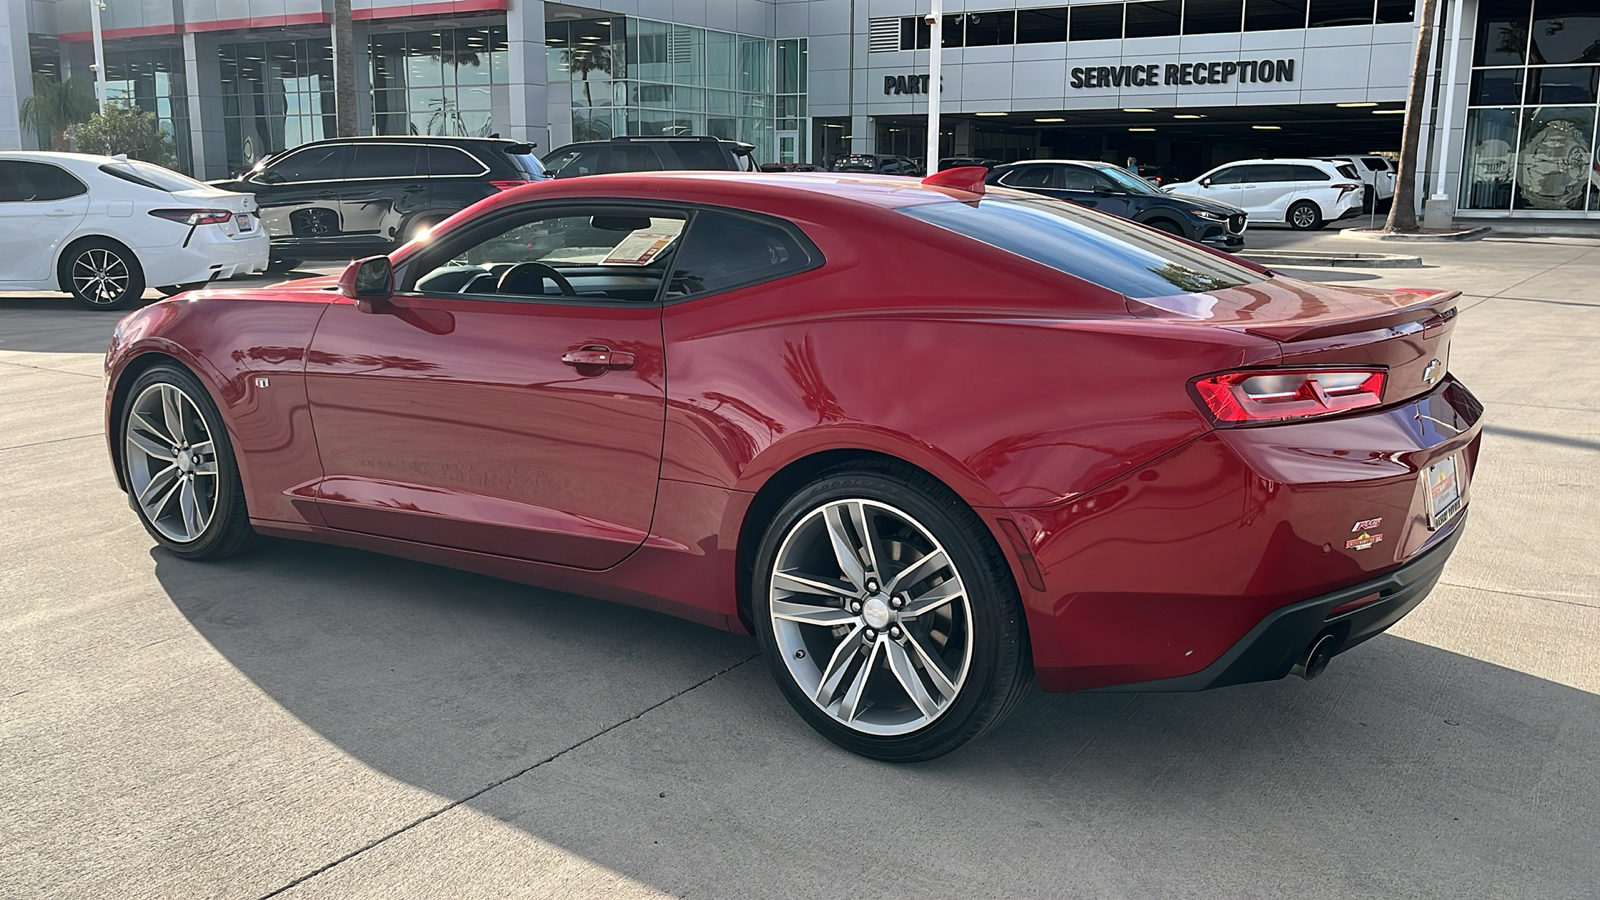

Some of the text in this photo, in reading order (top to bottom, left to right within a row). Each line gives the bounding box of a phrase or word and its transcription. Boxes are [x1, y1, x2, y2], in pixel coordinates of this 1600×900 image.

[884, 74, 943, 96] PART
[1070, 59, 1295, 89] SERVICE RECEPTION
